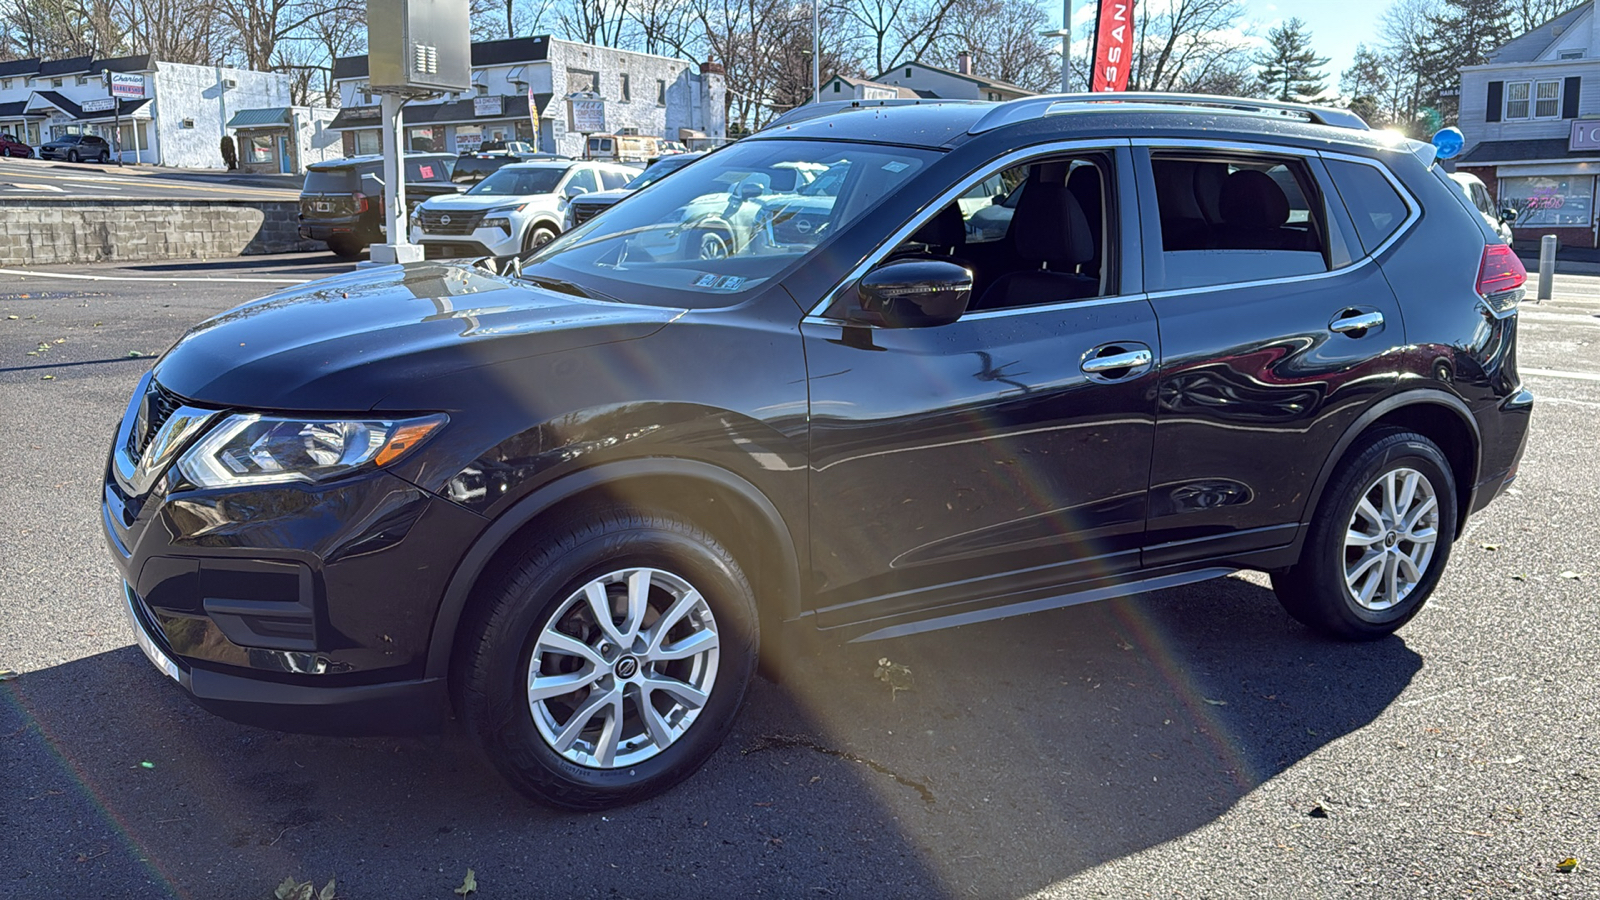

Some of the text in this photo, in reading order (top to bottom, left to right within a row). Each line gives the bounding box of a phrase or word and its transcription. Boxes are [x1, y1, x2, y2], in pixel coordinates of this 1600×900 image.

[1104, 3, 1127, 92] ISSAN
[113, 75, 143, 83] Charles
[575, 109, 603, 117] COMPUTERS
[456, 134, 482, 144] COMPUTERS
